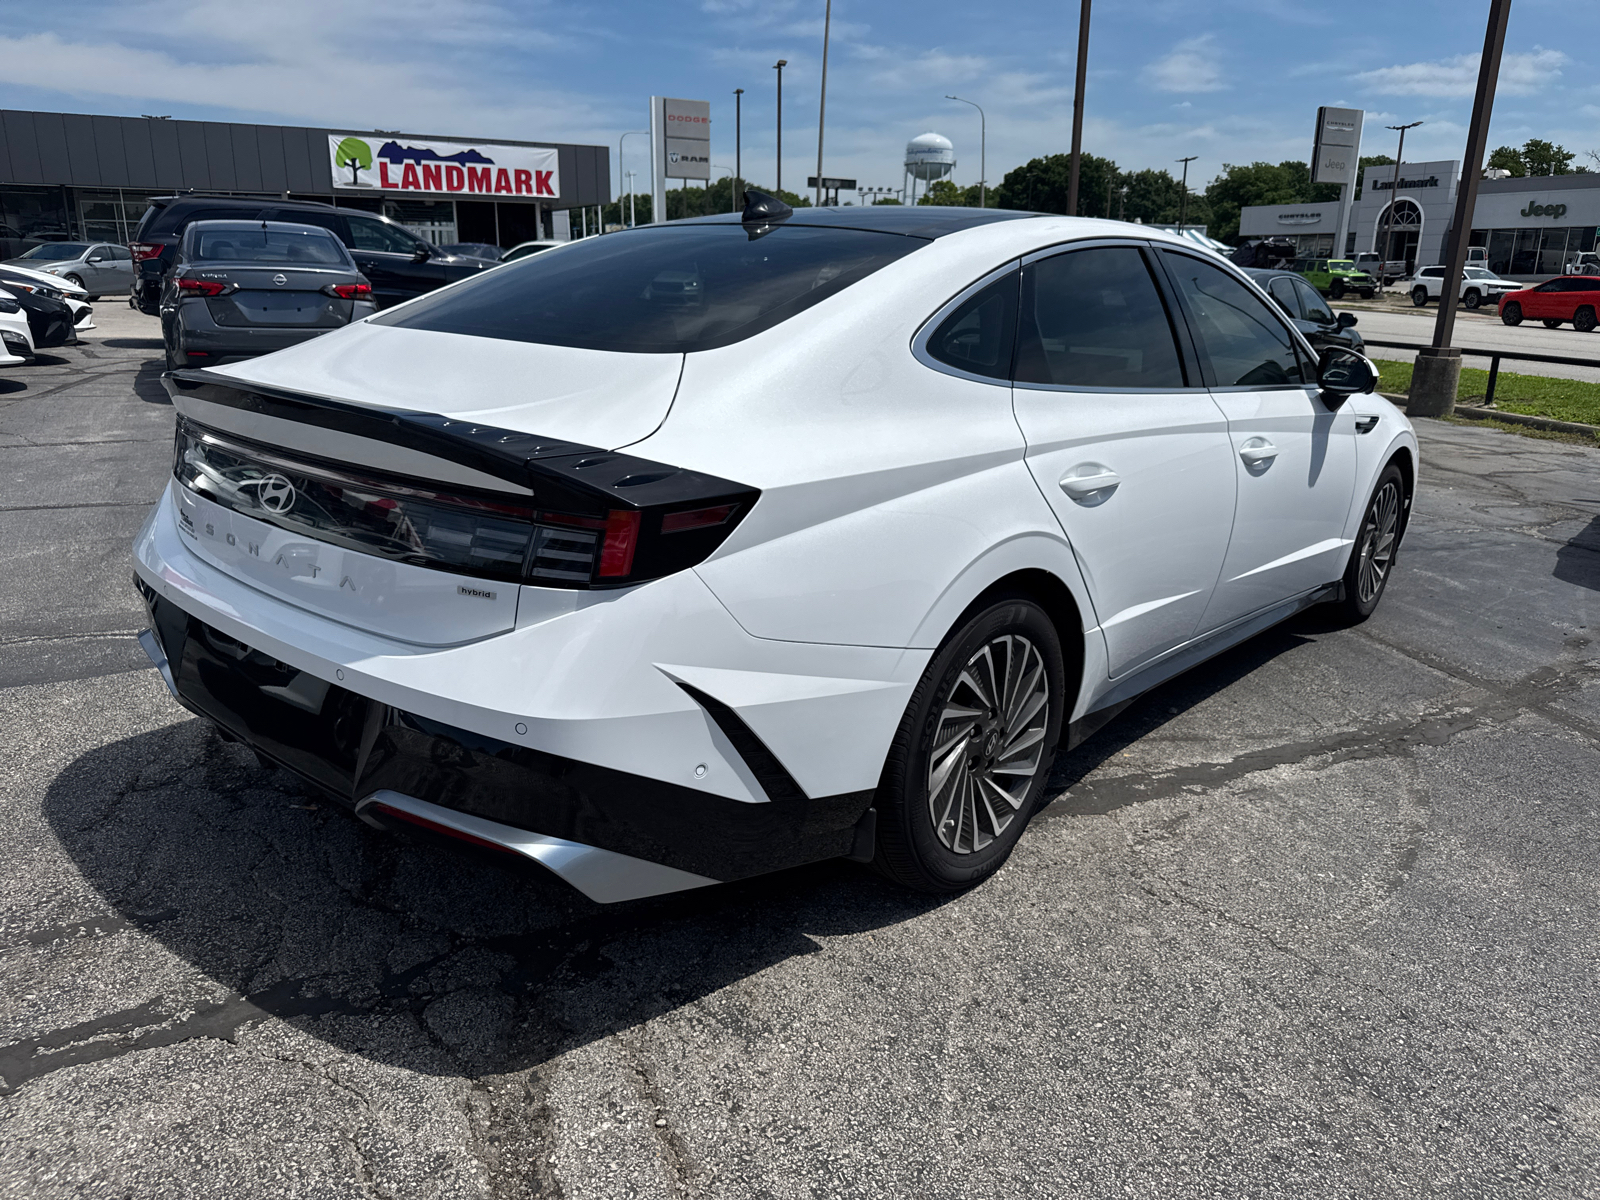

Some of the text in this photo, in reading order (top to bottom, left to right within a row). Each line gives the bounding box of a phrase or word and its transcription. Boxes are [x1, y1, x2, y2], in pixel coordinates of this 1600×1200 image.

[668, 114, 708, 123] DODGE
[681, 155, 709, 163] RAM
[1325, 158, 1346, 171] Jeep
[379, 161, 555, 195] LANDMARK
[1372, 176, 1439, 190] Landmark
[1520, 200, 1567, 219] Jeep
[205, 523, 357, 592] SONATA
[461, 586, 491, 598] hybrid
[921, 666, 956, 752] SOLUS
